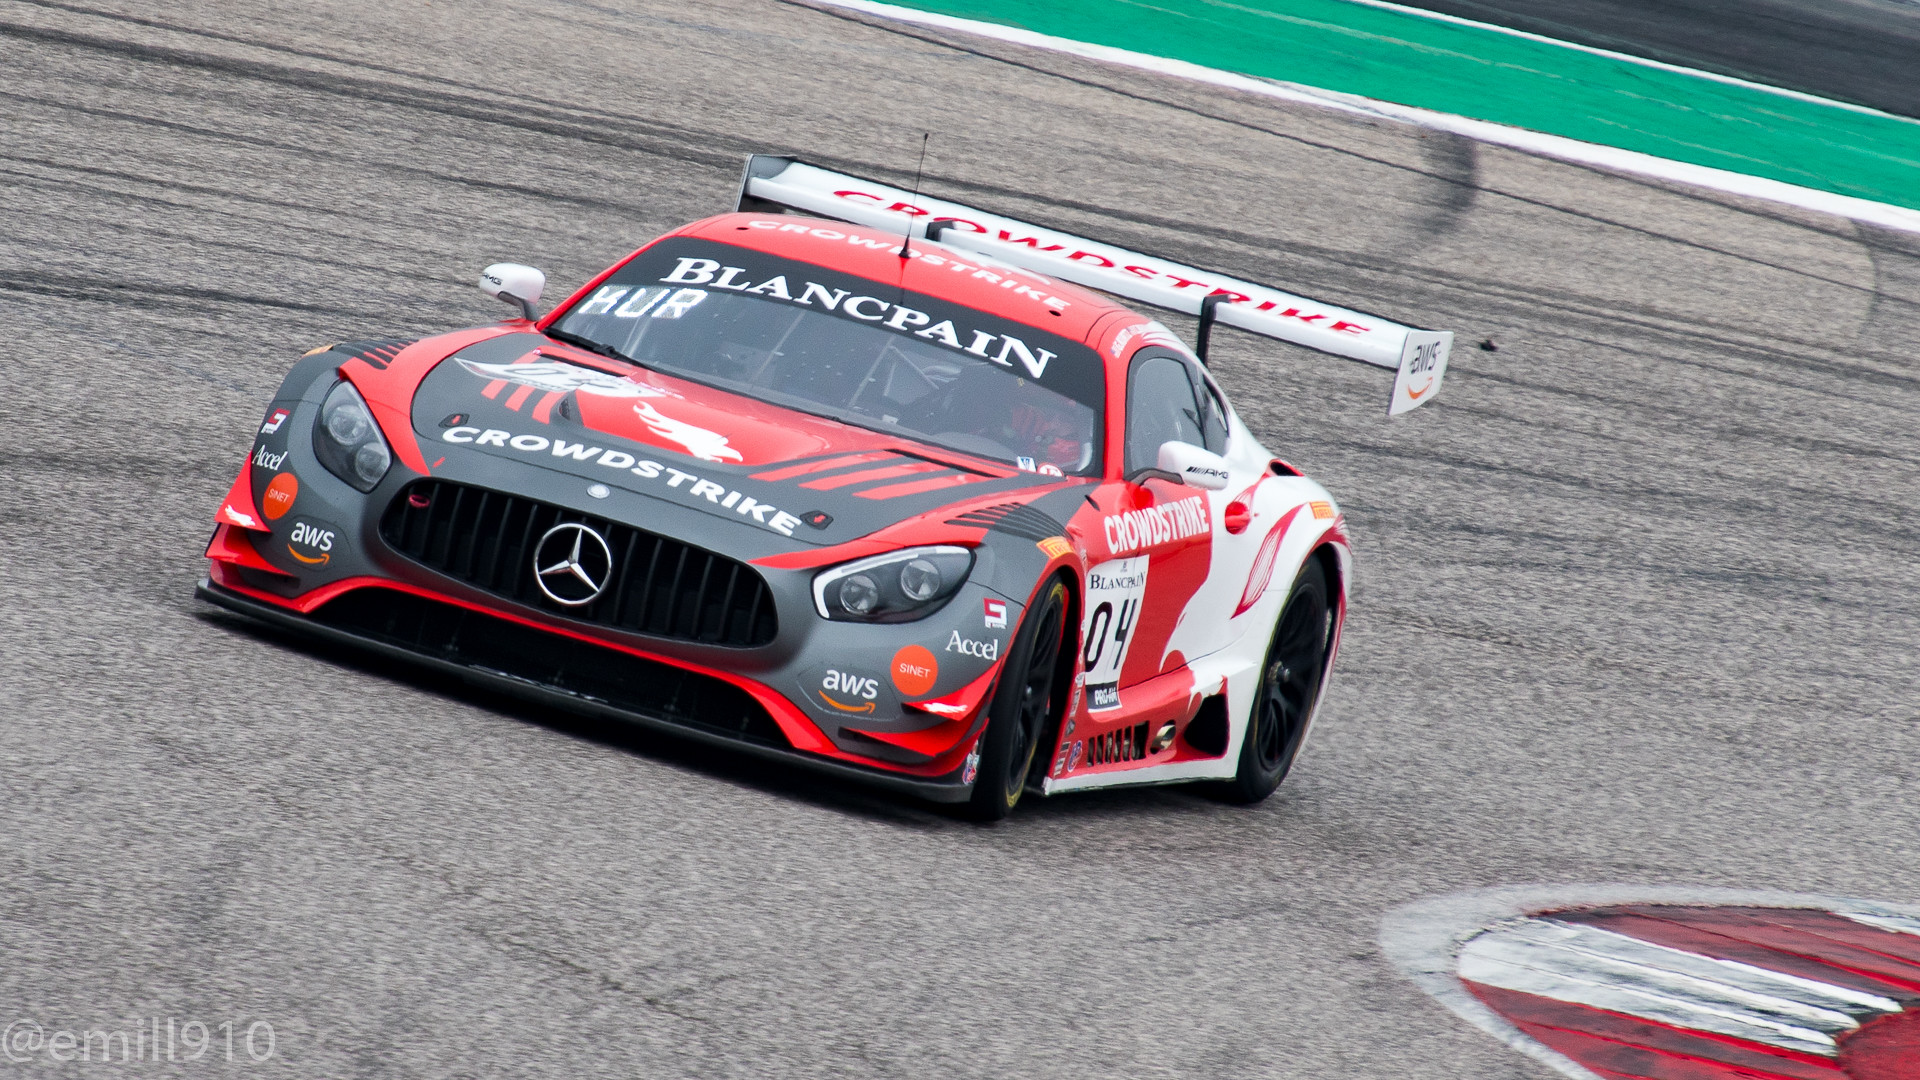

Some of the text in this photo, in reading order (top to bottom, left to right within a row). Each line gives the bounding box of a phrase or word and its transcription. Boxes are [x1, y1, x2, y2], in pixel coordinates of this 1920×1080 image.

[747, 220, 1072, 311] CROWDSTRIKE
[832, 189, 1371, 336] CROWDSTRIKE
[659, 257, 1058, 379] BLANCPAIN
[252, 444, 288, 471] Accel
[268, 488, 290, 503] SINET
[441, 426, 802, 537] CROWDSTRIKE
[291, 521, 335, 552] aws
[1103, 495, 1210, 555] CROWDSTRIKE
[1089, 571, 1146, 590] BLANCPAIN
[945, 629, 999, 661] Accel
[1083, 598, 1138, 673] 04
[822, 668, 879, 700] aws
[899, 662, 931, 679] SINET
